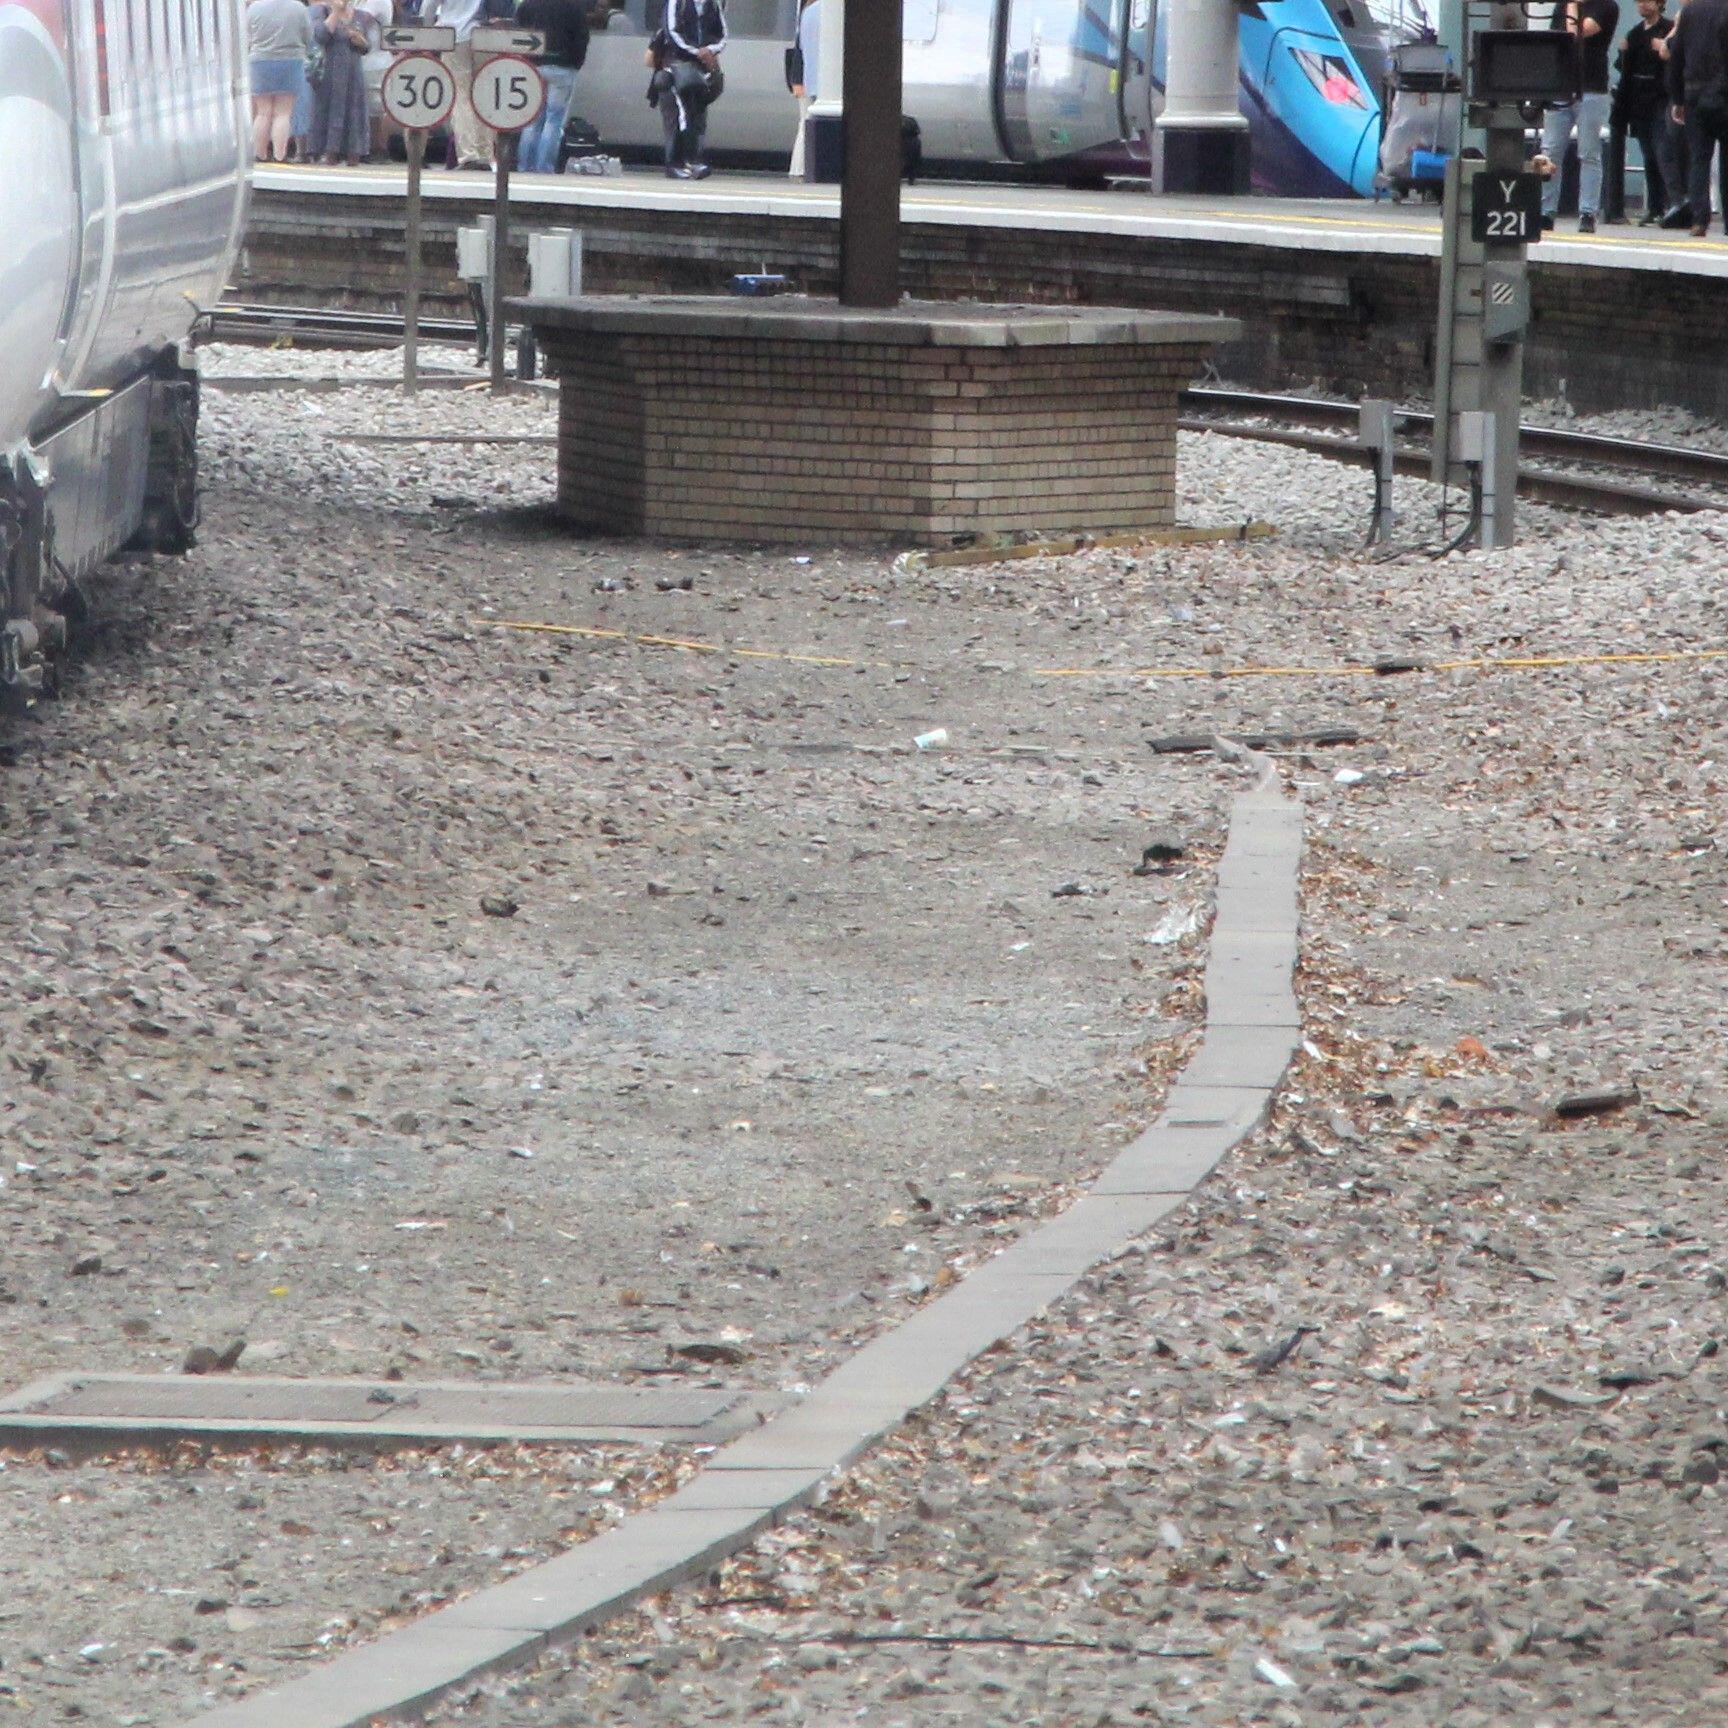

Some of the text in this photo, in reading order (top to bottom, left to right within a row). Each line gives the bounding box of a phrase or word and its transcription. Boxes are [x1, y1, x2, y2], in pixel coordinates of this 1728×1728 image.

[397, 75, 444, 110] 30
[495, 76, 528, 111] 15
[1499, 180, 1517, 203] Y
[1487, 211, 1526, 236] 221
